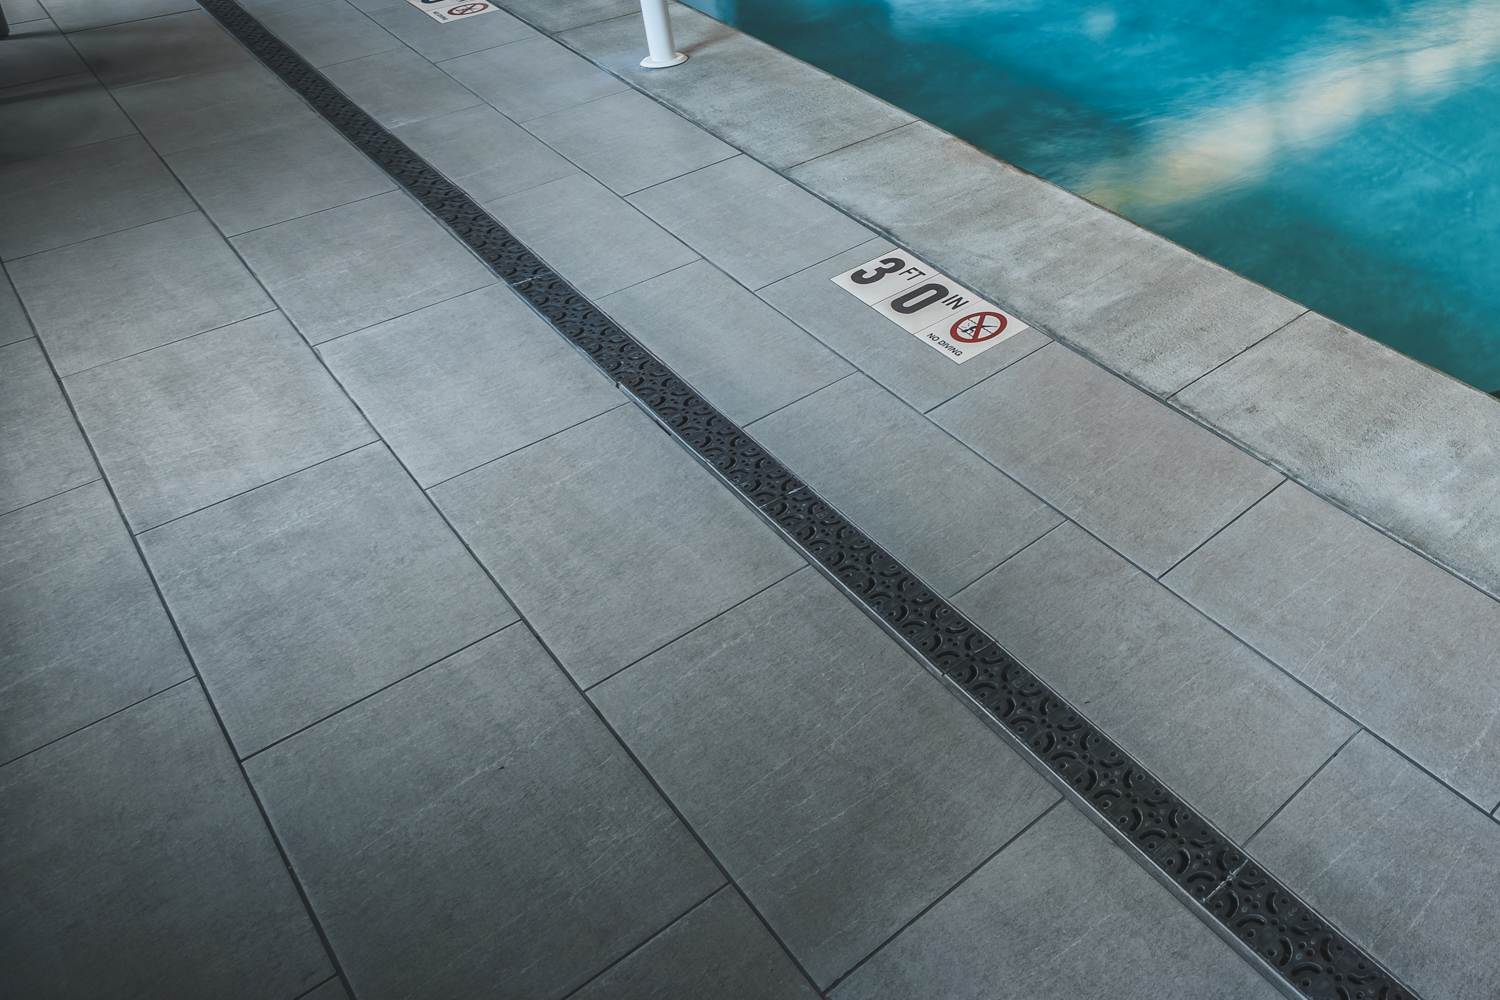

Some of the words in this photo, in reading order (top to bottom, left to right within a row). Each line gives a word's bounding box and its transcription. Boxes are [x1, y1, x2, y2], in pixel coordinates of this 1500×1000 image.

[850, 257, 906, 285] 3
[898, 266, 926, 281] FT
[890, 283, 950, 315] 0
[941, 294, 970, 311] IN
[926, 332, 940, 343] NO
[937, 340, 964, 357] DIVING
